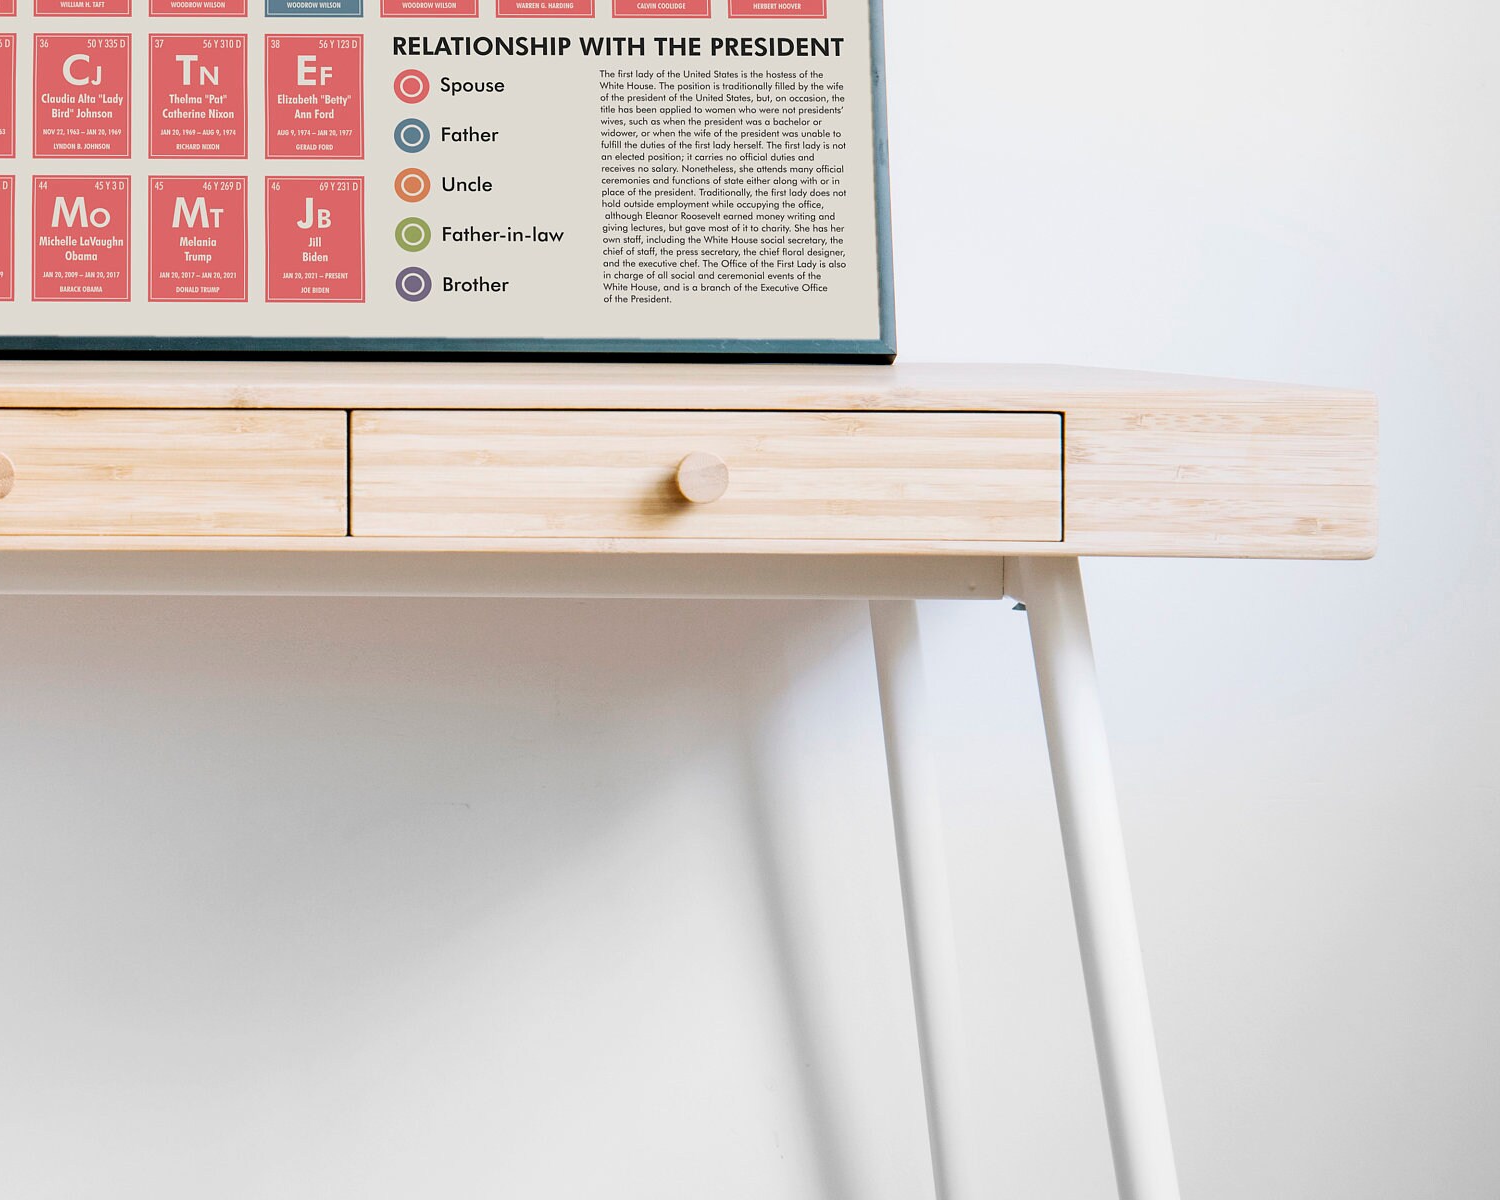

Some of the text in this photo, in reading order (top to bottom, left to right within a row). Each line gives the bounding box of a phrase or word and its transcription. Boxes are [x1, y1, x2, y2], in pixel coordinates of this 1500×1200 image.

[393, 37, 844, 56] RELATIONSHIP WITH THE PRESIDENT
[599, 69, 823, 80] The first lady of the United States is the hostess of the
[441, 77, 505, 96] Spouse
[442, 126, 499, 142] Father
[442, 176, 492, 192] Uncle
[443, 226, 564, 242] Father-in-law
[180, 236, 217, 247] Melania
[308, 237, 321, 247] Jill
[184, 251, 212, 263] Trump
[302, 251, 328, 262] Biden
[443, 276, 509, 292] Brother
[603, 294, 671, 303] of the President.
